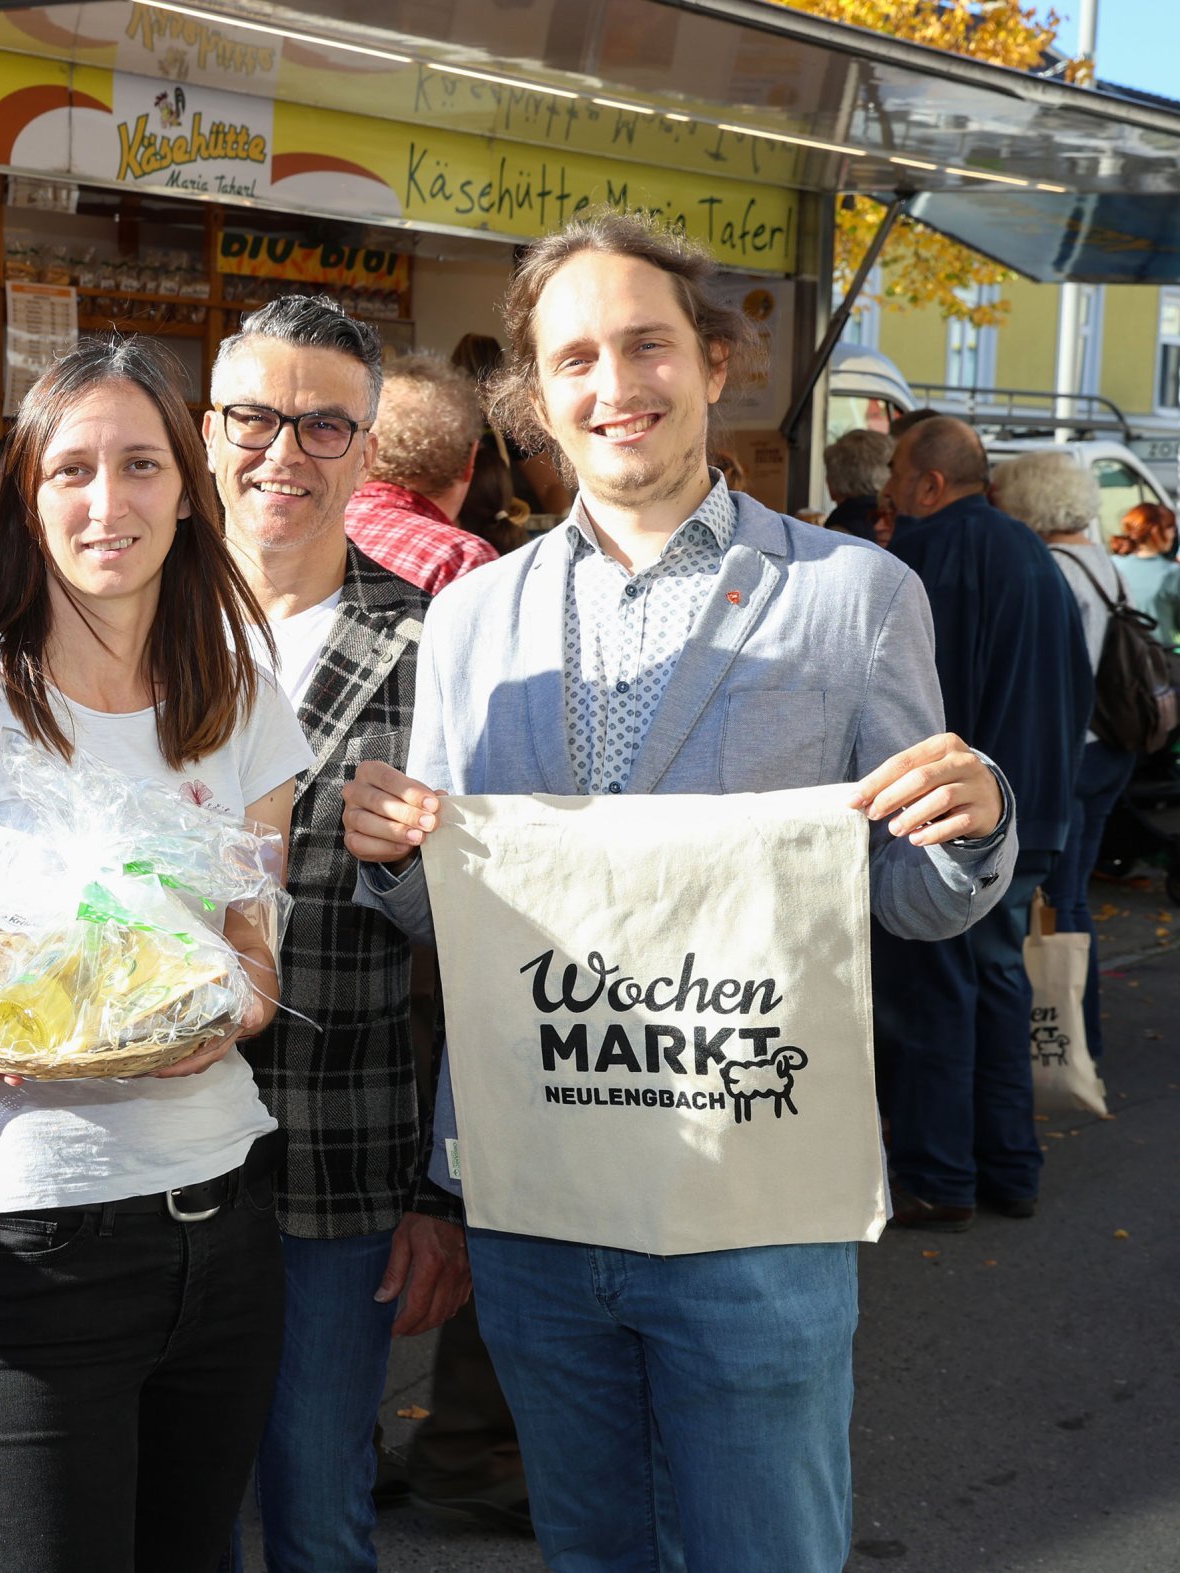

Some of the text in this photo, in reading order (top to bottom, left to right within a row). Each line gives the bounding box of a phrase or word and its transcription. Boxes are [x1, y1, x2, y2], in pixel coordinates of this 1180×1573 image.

[117, 112, 267, 181] Käsehütte
[165, 169, 208, 192] Maria
[405, 142, 591, 226] Käsehütte
[698, 196, 792, 259] Taferl
[520, 949, 783, 1015] Wochen
[540, 1024, 781, 1076] MARKT
[544, 1085, 726, 1110] NEULENGBACH
